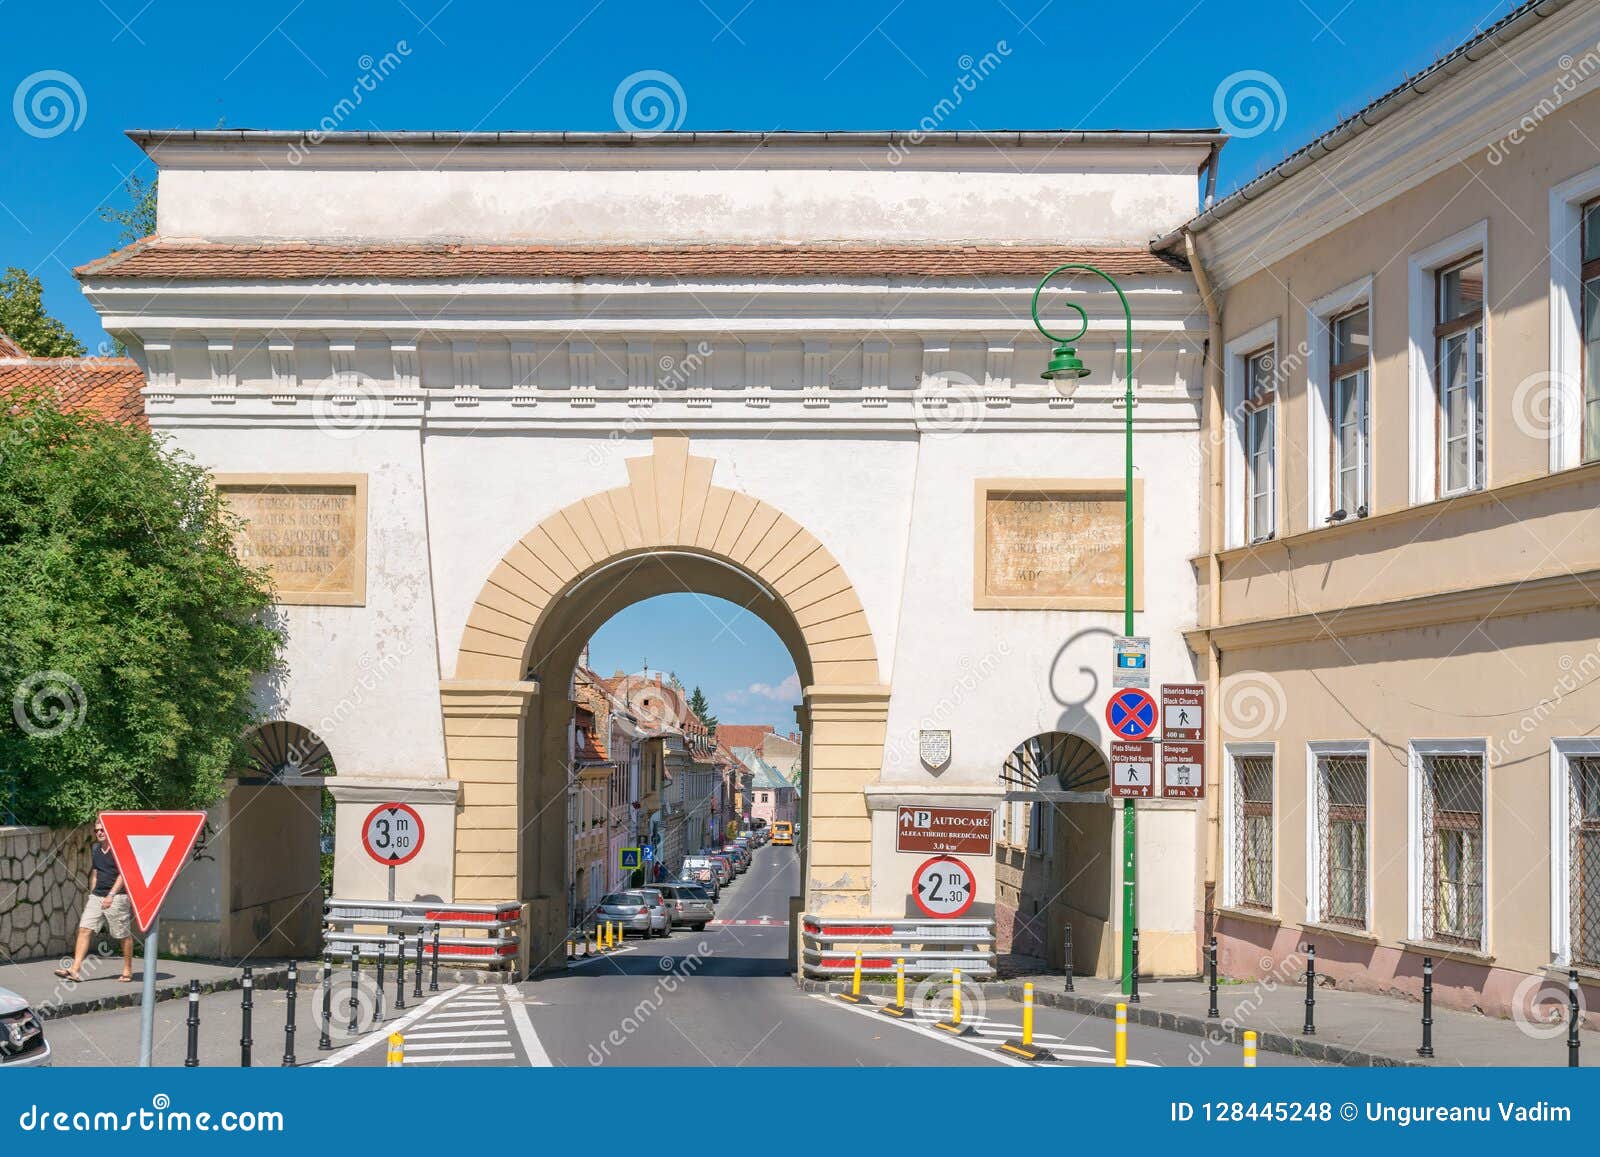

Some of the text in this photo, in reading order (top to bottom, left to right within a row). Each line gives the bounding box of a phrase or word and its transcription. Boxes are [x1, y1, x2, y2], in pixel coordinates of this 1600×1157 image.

[1164, 745, 1188, 753] Sinagoga
[918, 811, 990, 827] P AUTOCARE
[901, 830, 922, 838] ALEEA
[948, 832, 990, 840] BREDICEANU
[933, 842, 957, 851] 3.0 km
